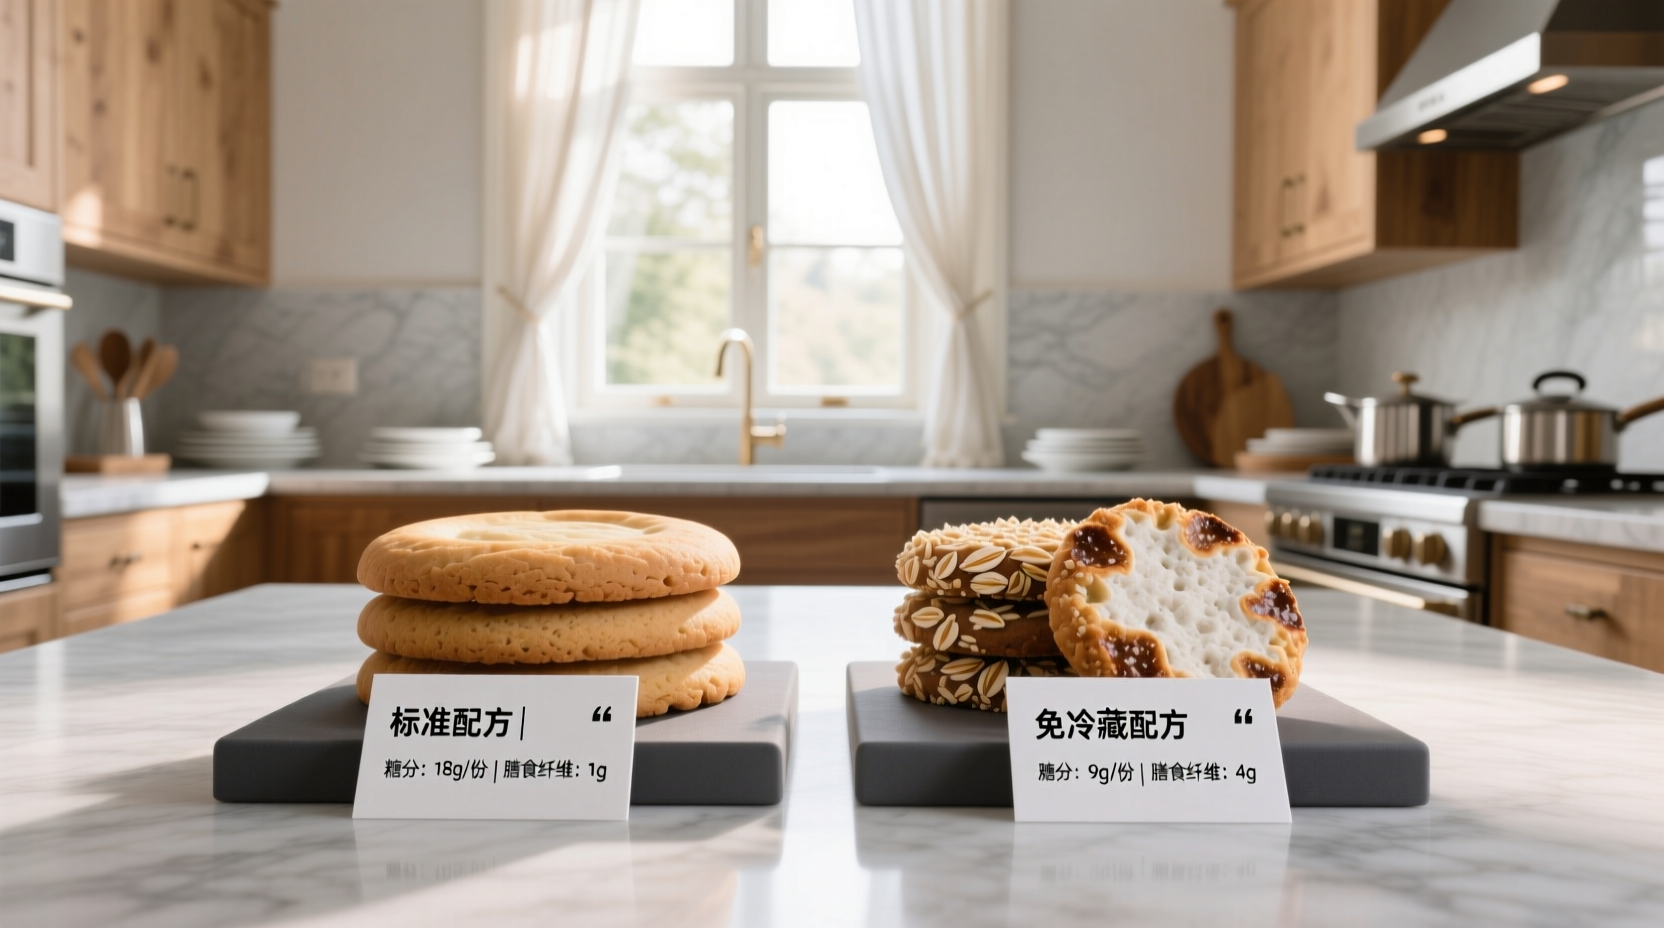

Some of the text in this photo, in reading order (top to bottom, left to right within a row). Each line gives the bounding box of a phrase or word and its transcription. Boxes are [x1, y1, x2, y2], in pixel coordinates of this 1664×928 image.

[389, 706, 514, 738] 标准配方
[1034, 706, 1188, 741] 免冷藏配方
